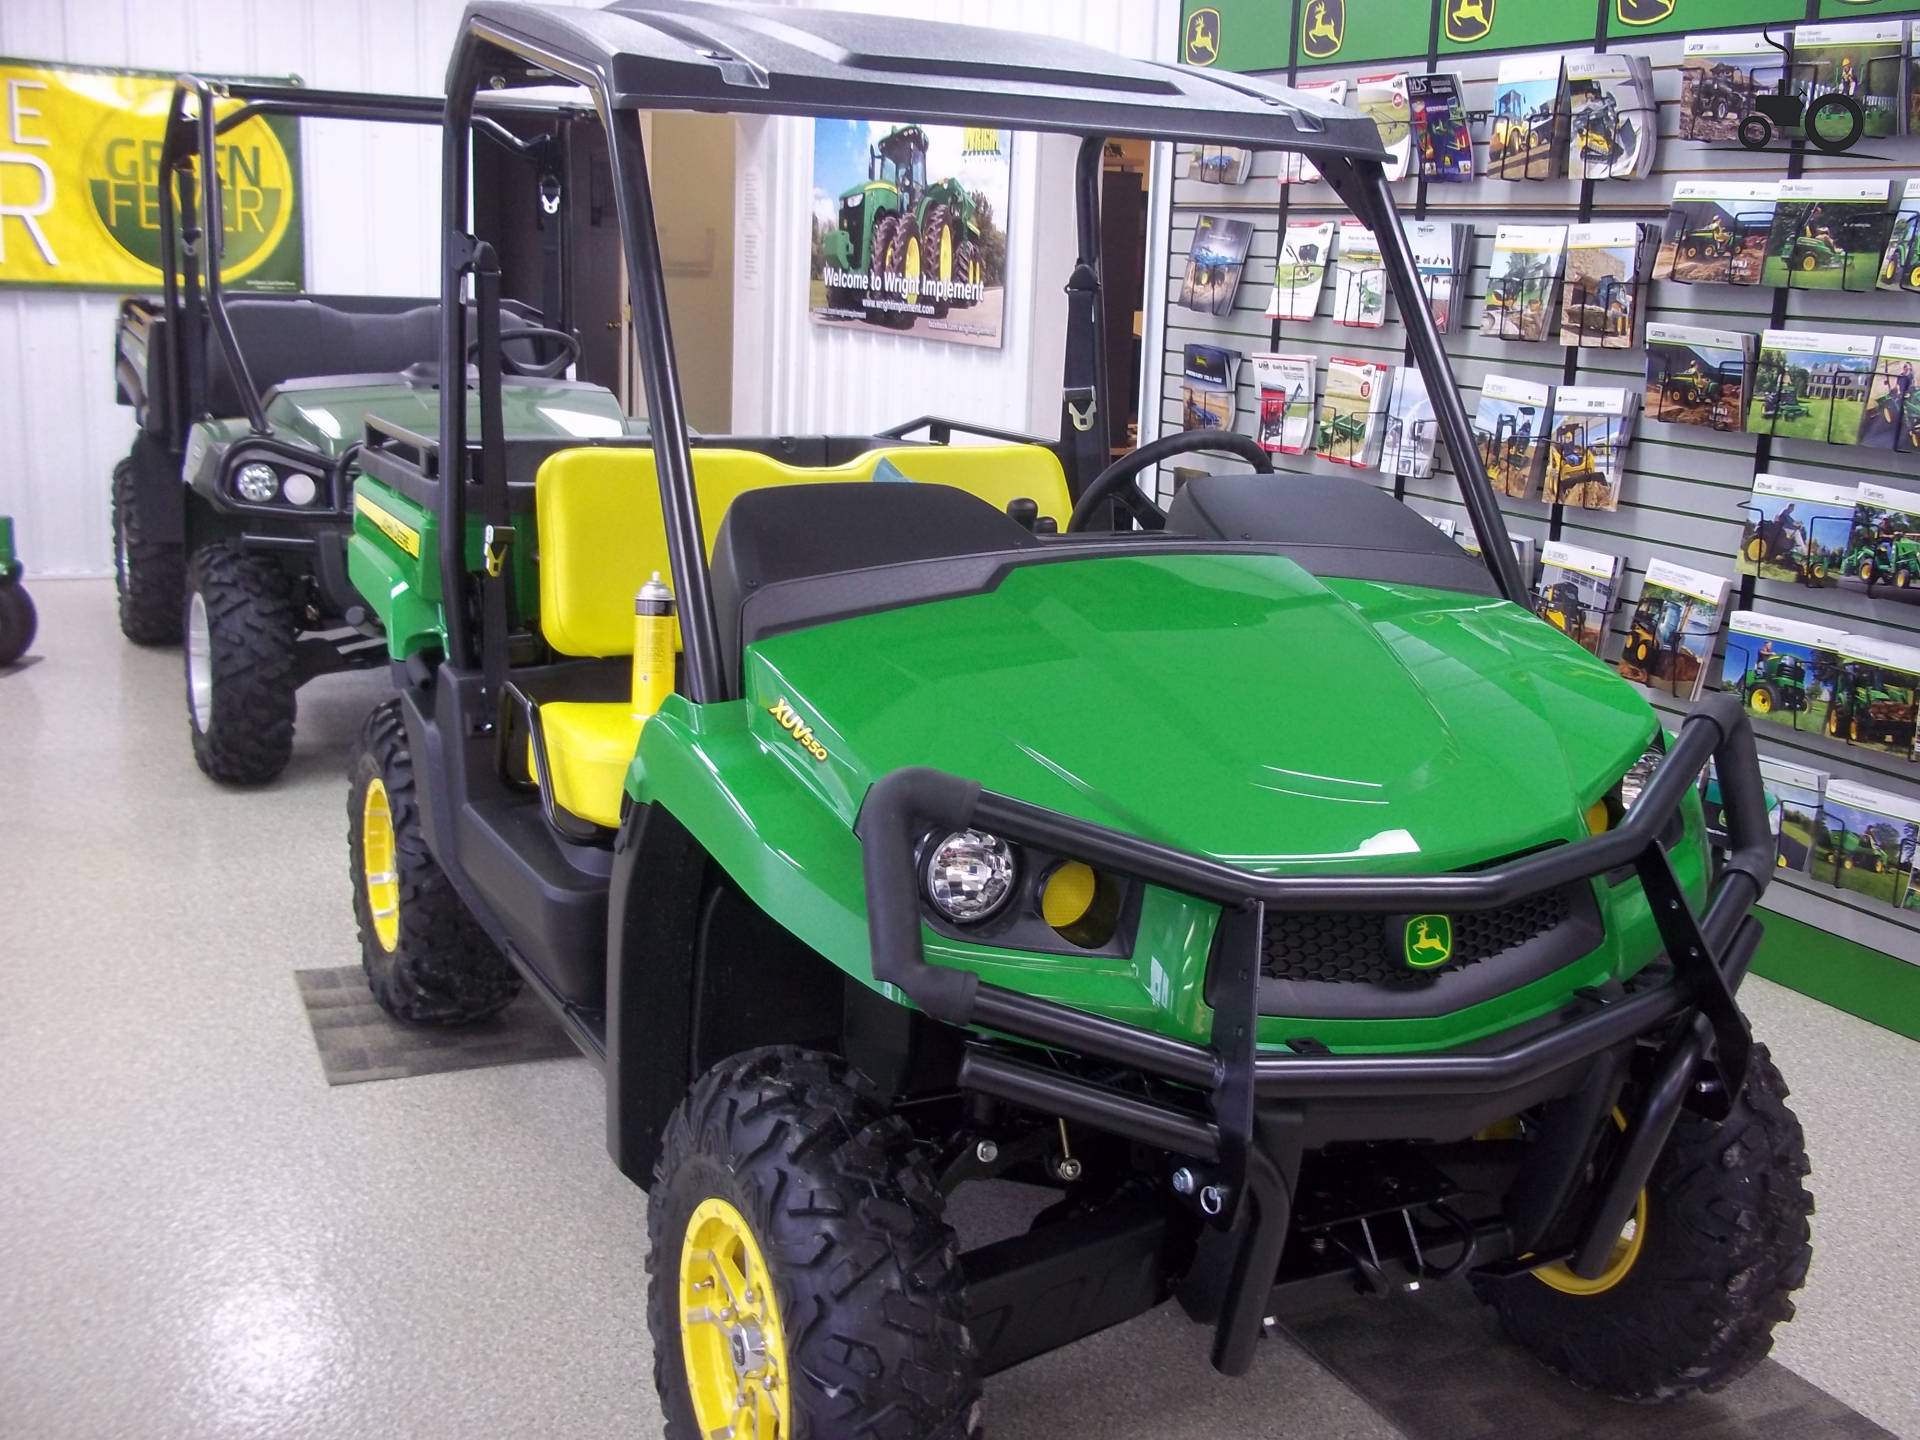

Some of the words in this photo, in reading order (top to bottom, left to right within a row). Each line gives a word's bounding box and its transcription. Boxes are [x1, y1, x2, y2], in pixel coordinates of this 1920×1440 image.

[823, 266, 869, 291] Welcome
[870, 270, 882, 291] to
[884, 272, 920, 299] Wright
[922, 274, 984, 302] Implement
